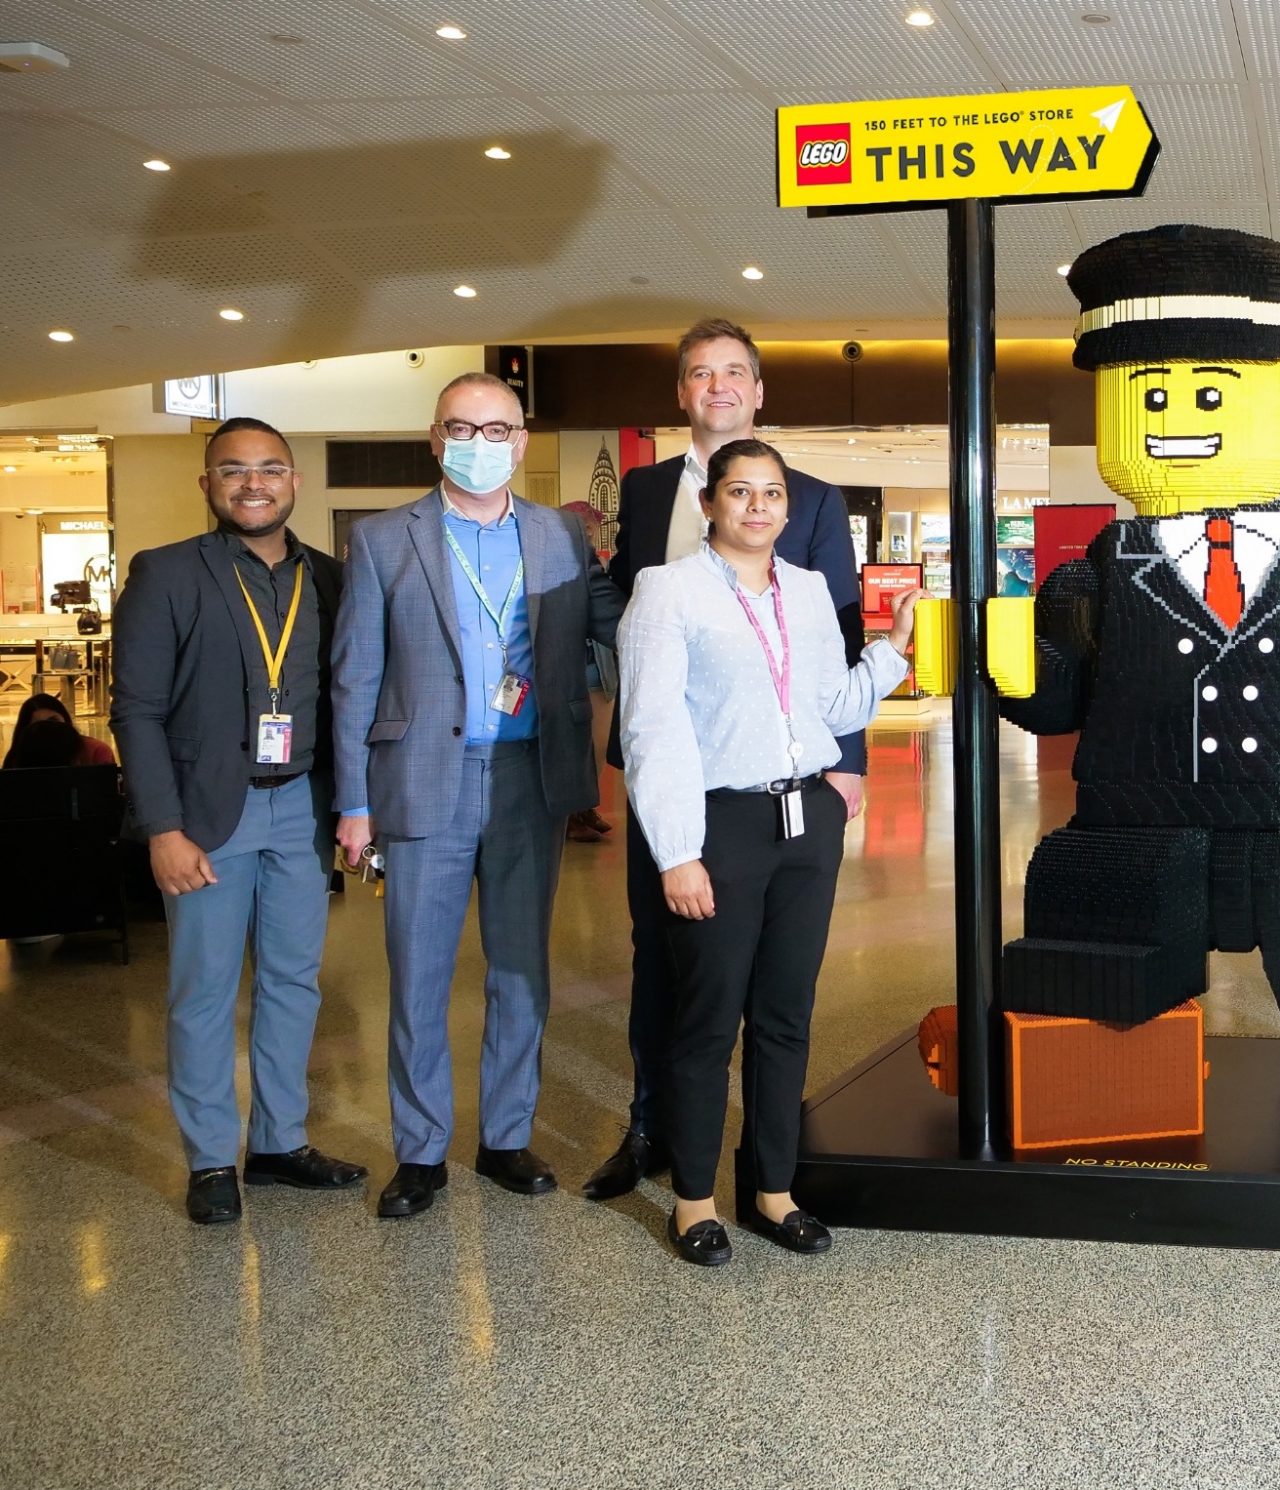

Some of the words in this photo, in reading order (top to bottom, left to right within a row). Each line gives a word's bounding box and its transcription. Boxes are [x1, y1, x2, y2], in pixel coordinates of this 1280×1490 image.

[865, 120, 887, 131] 150
[893, 118, 924, 130] FEET
[929, 116, 947, 128] TO
[954, 114, 979, 126] THE
[1029, 108, 1074, 121] STORE
[800, 140, 848, 167] LEGO
[866, 142, 976, 182] THIS
[998, 134, 1106, 175] WAY
[1065, 1158, 1097, 1166] NO
[1103, 1159, 1209, 1171] STANDING
